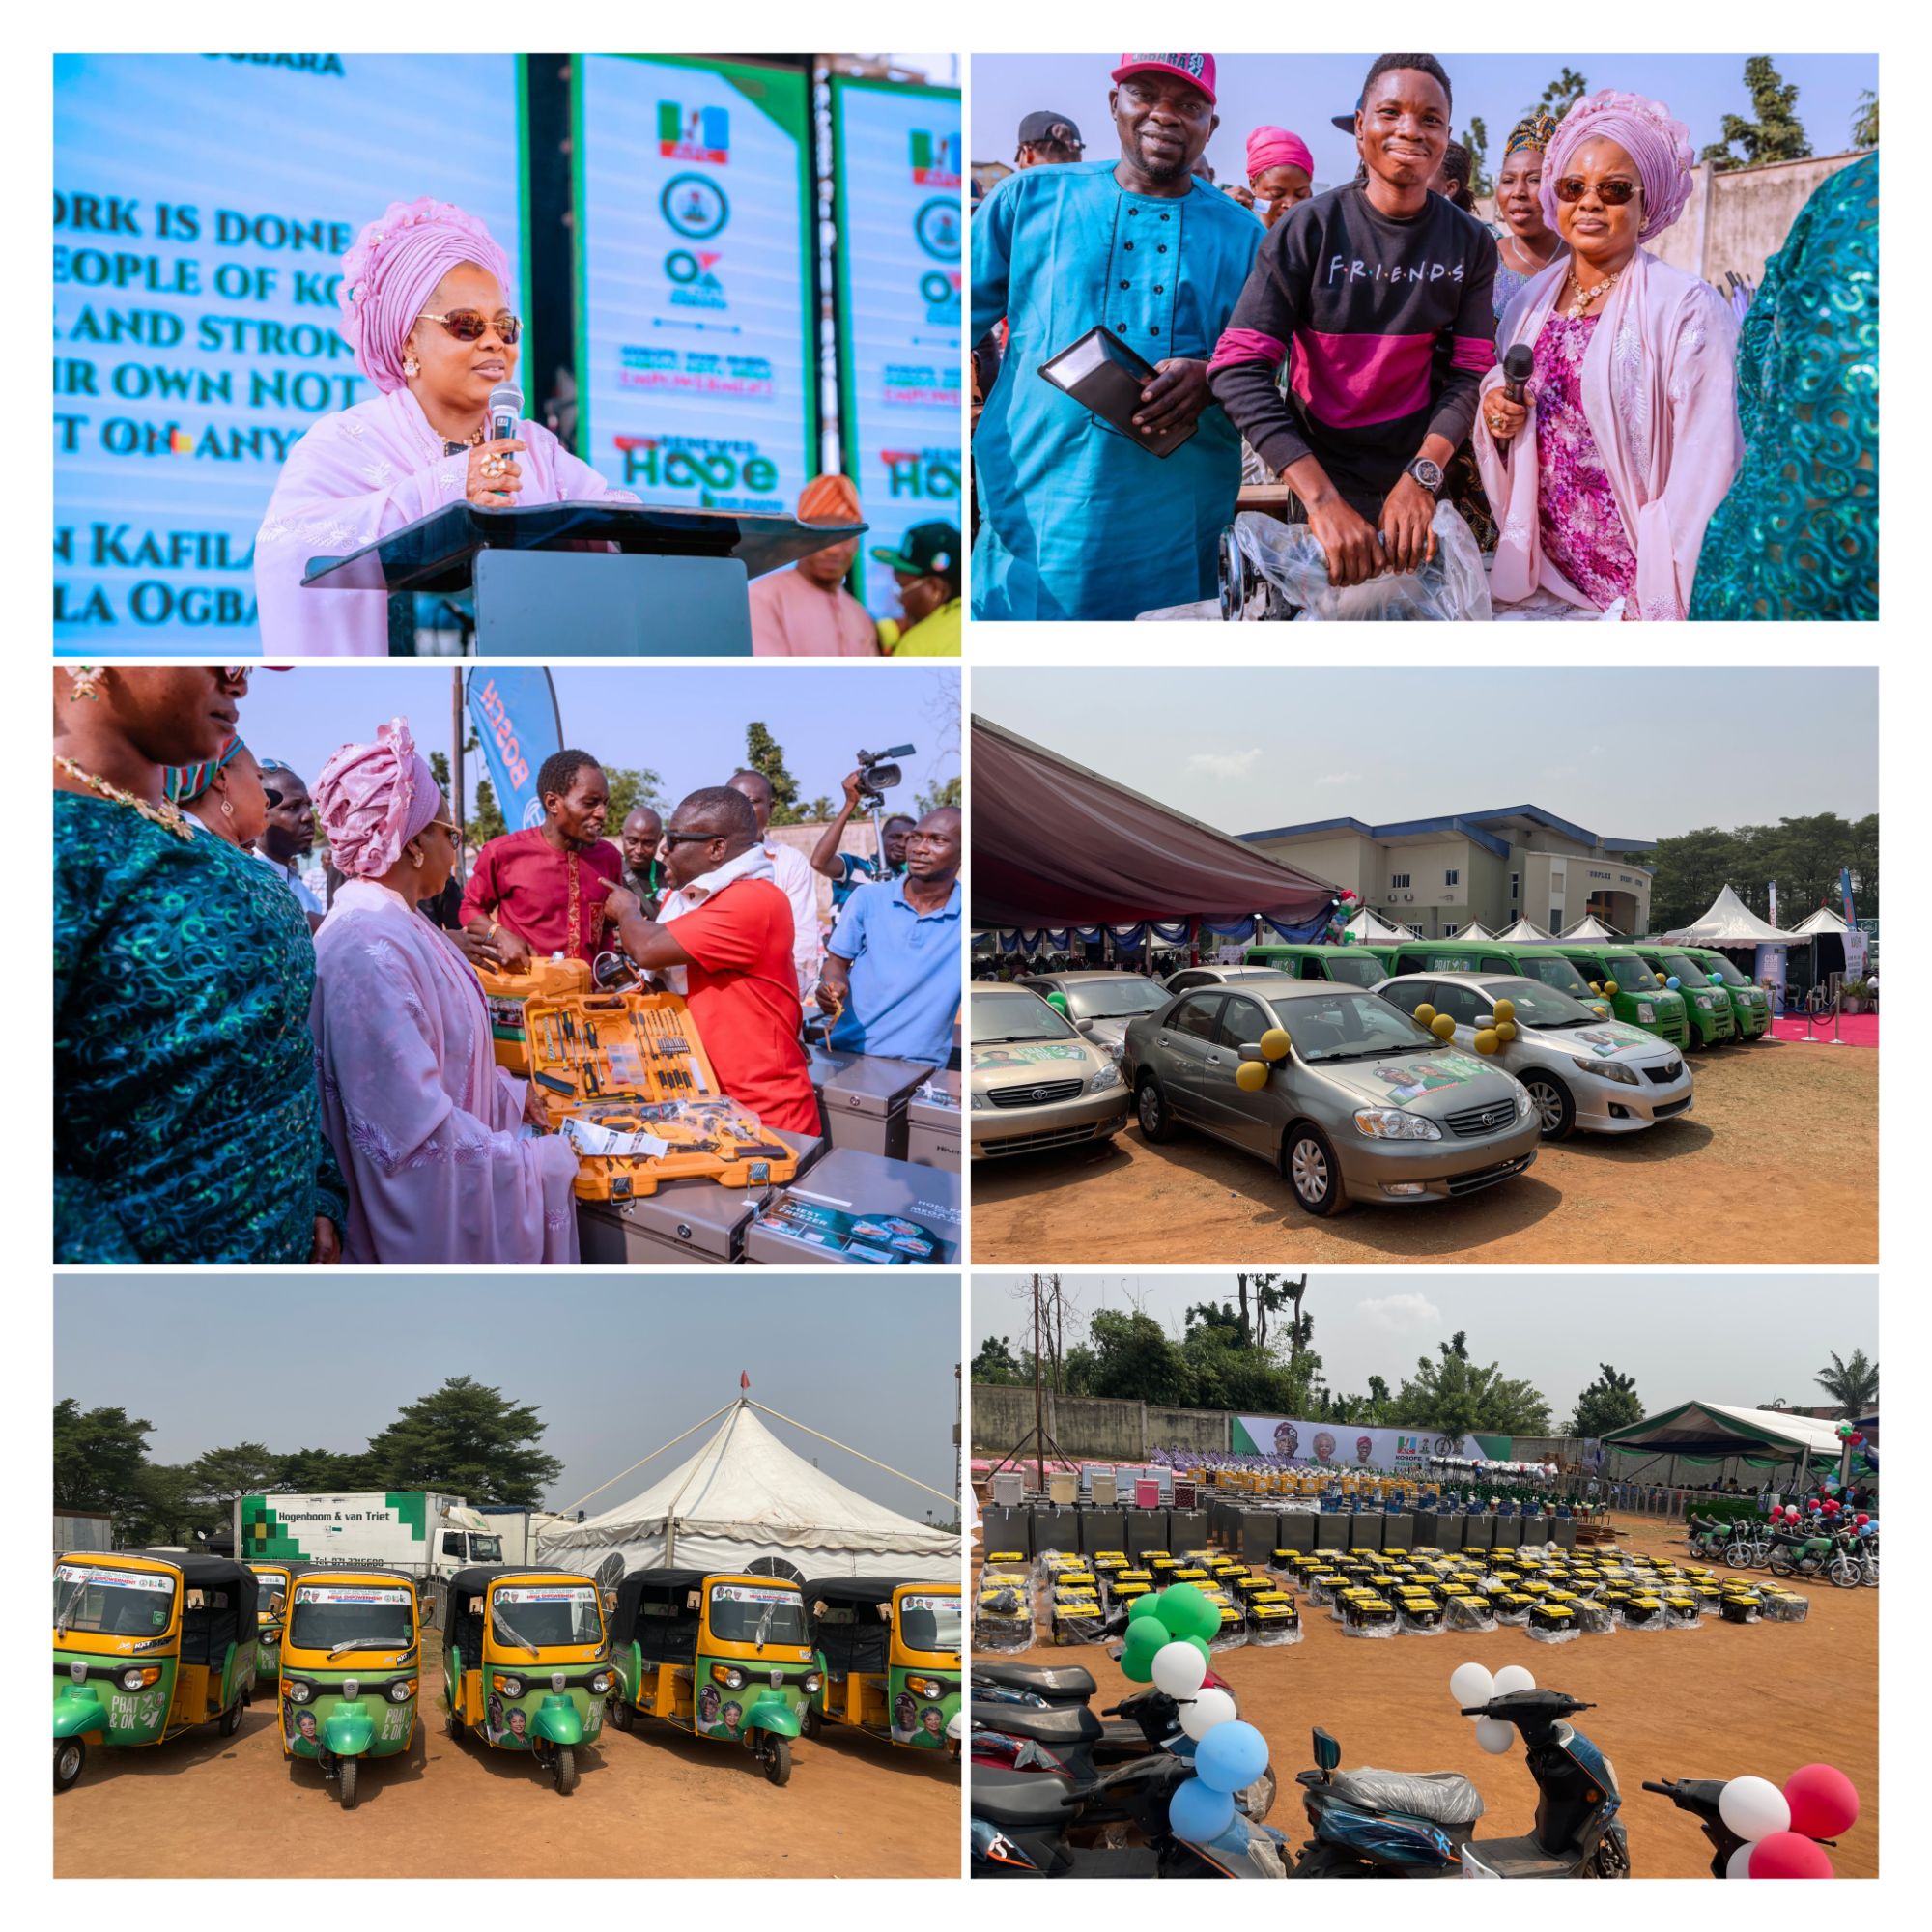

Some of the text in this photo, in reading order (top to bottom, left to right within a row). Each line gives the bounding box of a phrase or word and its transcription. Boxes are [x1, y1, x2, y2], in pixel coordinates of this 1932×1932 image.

[156, 203, 199, 242] IS
[215, 209, 351, 254] DONE
[214, 263, 277, 301] OF
[70, 303, 185, 348] AND
[111, 362, 232, 404] OWN
[250, 369, 365, 412] NOT
[778, 1208, 828, 1226] FREEZER
[782, 1204, 820, 1218] CHEST
[279, 1512, 390, 1522] Hogenboom & van Triet
[94, 1576, 136, 1585] EMPOWERMENT
[111, 1695, 140, 1713] PBAT
[109, 1712, 118, 1728] &
[120, 1714, 136, 1729] OK
